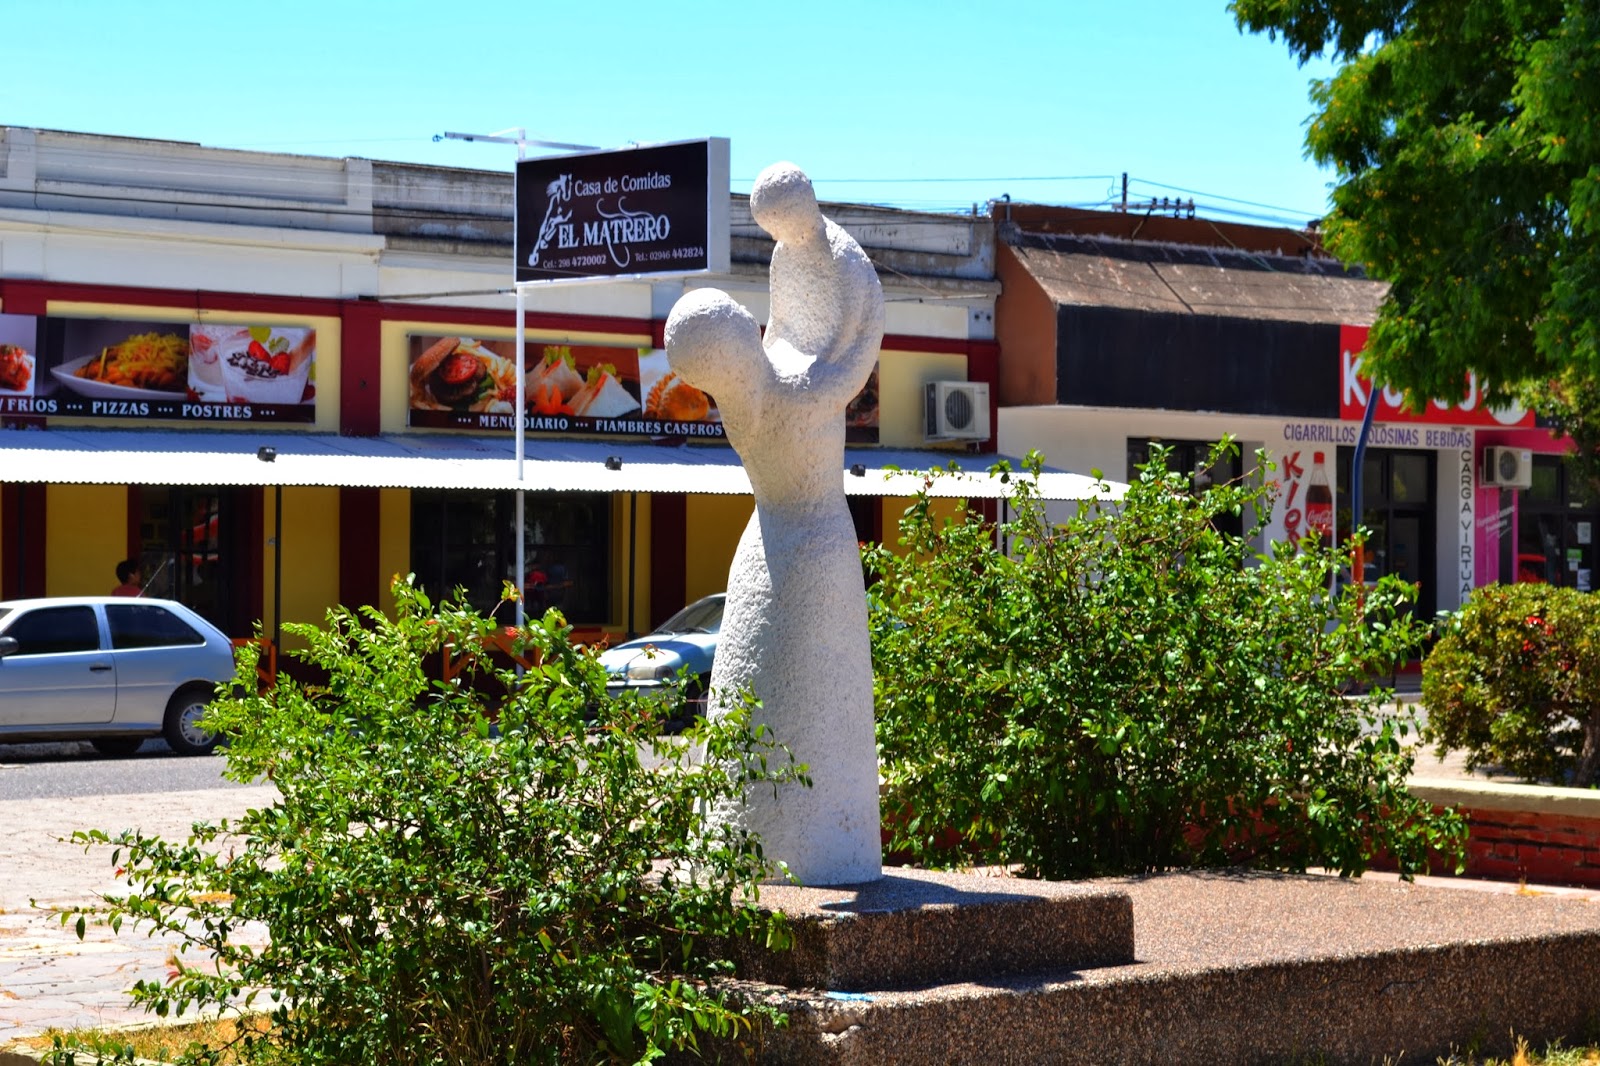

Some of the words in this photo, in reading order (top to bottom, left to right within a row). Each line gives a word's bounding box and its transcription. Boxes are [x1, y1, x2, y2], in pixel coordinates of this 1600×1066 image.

[574, 180, 601, 197] Casa
[604, 177, 618, 194] de
[621, 171, 671, 192] Comidas
[558, 223, 580, 249] EL
[583, 208, 671, 255] MATRERO
[571, 254, 607, 267] 4720002
[649, 250, 671, 261] 02946
[671, 246, 705, 259] 442824
[92, 401, 150, 415] PIZZAS
[182, 404, 253, 418] POSTRES
[595, 420, 661, 434] FIAMBRES
[664, 422, 723, 436] CASEROS
[1283, 424, 1356, 444] CIGARRILLOS
[1368, 427, 1419, 447] OLOSINAS
[1425, 431, 1472, 448] BEBIDAS
[1460, 450, 1472, 514] CARGA
